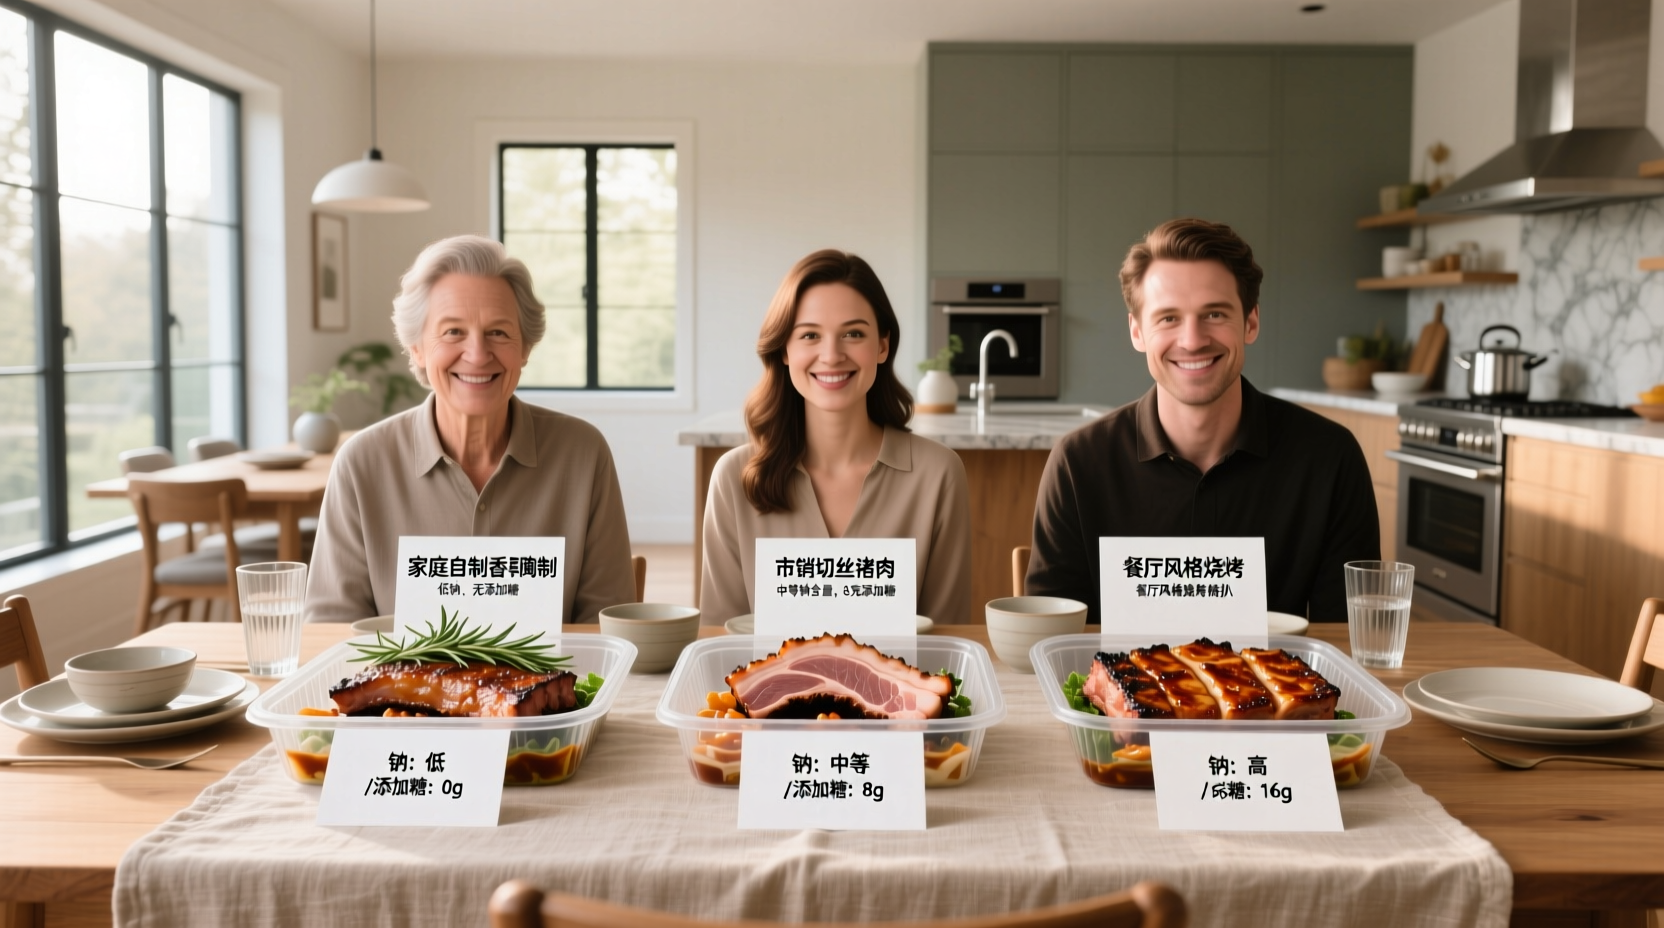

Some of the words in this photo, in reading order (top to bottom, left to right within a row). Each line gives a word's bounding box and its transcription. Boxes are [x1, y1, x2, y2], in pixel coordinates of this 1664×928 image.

[1122, 555, 1245, 579] 餐厅风格烧烤
